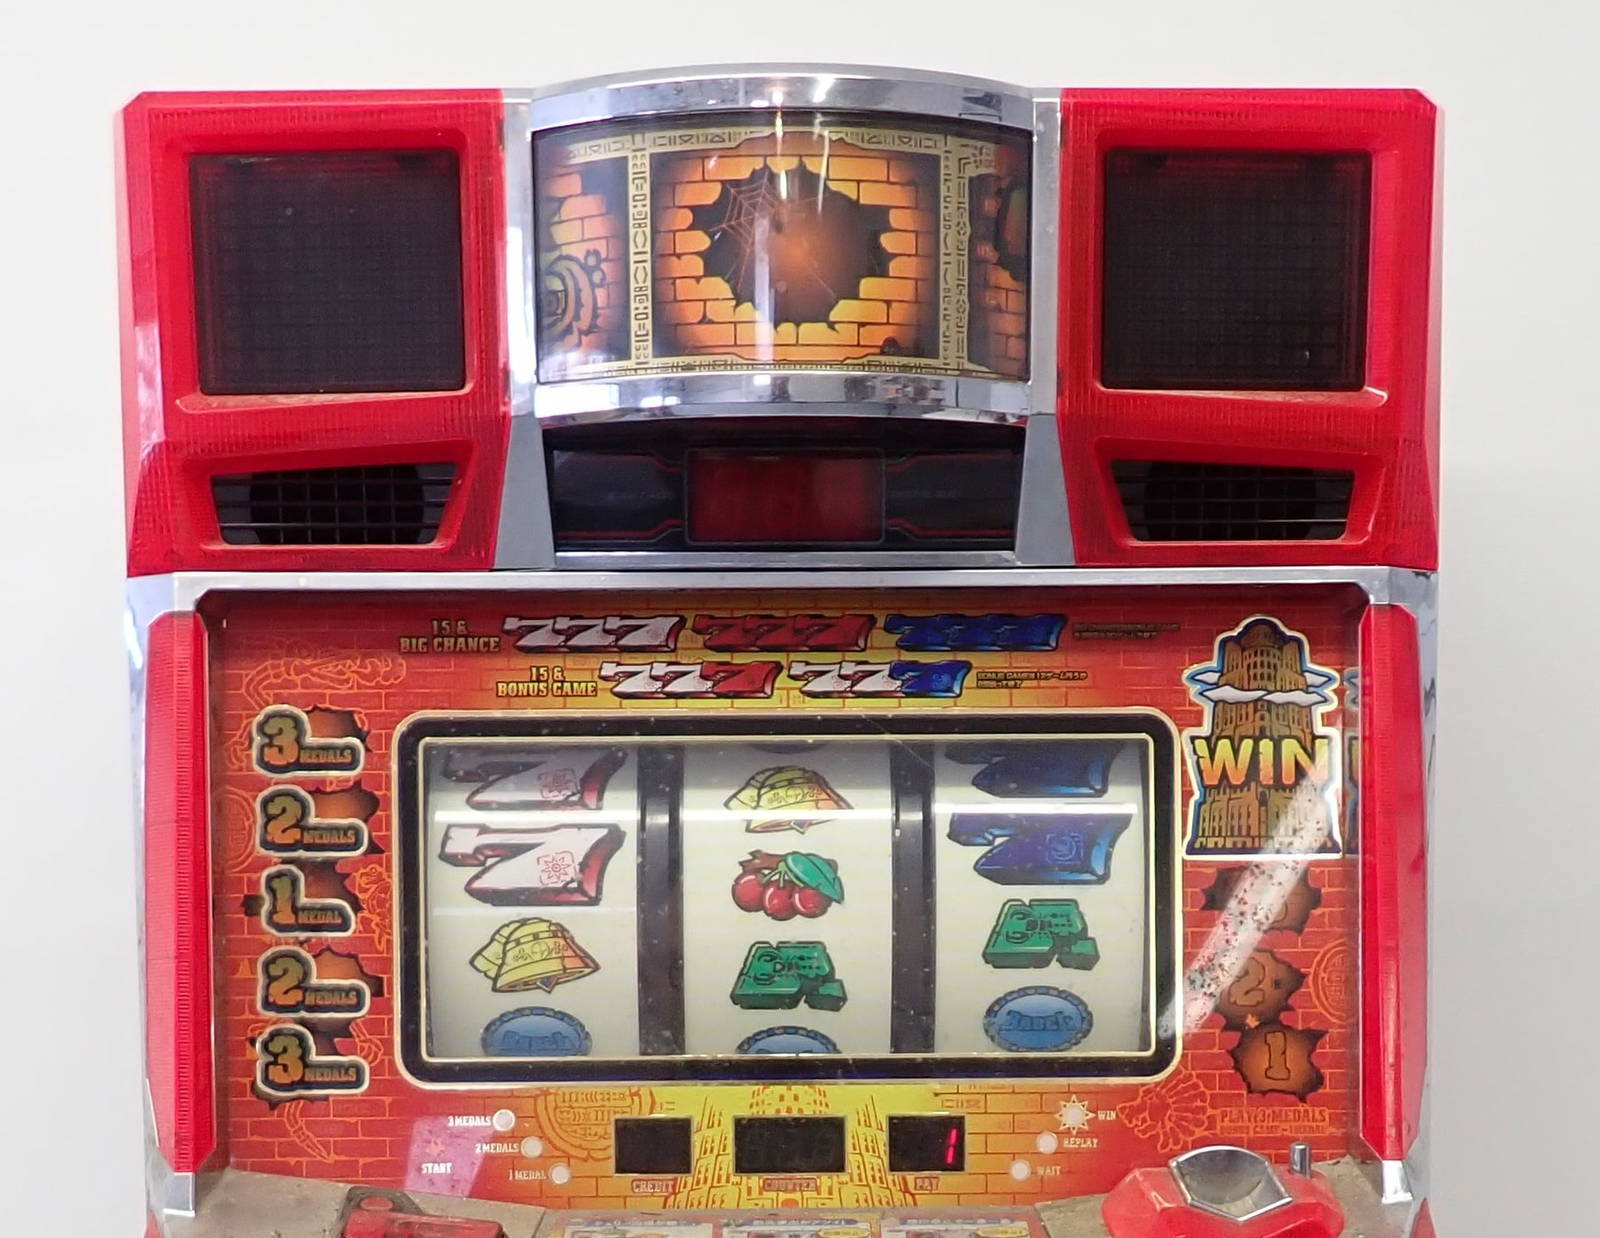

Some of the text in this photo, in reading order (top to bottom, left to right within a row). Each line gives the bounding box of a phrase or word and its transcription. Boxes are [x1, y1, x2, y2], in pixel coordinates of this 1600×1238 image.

[431, 620, 468, 635] 15 &
[399, 637, 500, 653] BIG CHANCE
[530, 666, 566, 682] 15 &
[497, 682, 598, 698] BONUS GAME
[262, 716, 352, 766] 3 MEDALS
[1192, 736, 1332, 787] WIN
[266, 796, 356, 845] 2 MEDALS
[271, 876, 342, 925] 1 MEDAL
[268, 956, 358, 1007] 2 MEDALS
[267, 1035, 358, 1084] 3 MEDALS
[1097, 1109, 1117, 1121] WIN
[1063, 1137, 1099, 1149] REPLAY
[421, 1162, 453, 1175] START
[1037, 1165, 1062, 1176] WAIT
[632, 1180, 677, 1193] CREDIT
[764, 1179, 817, 1192] COUNTER
[915, 1177, 940, 1192] PAY
